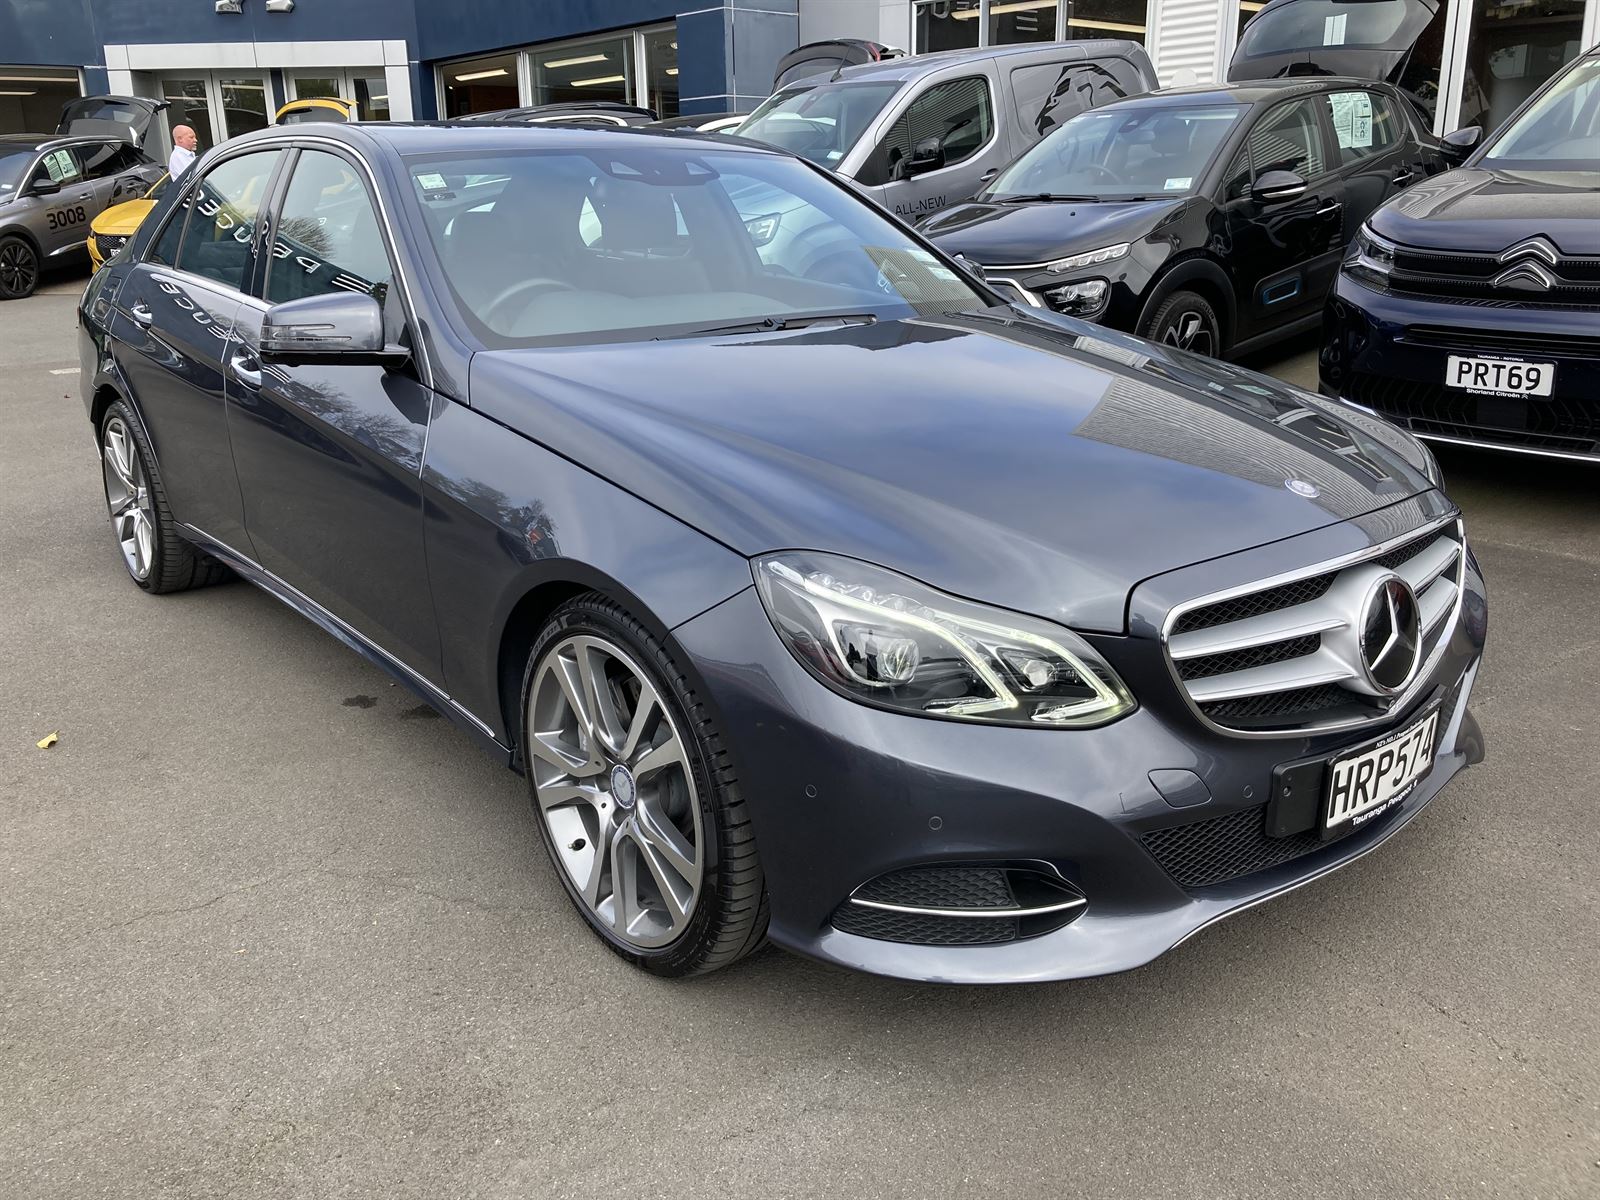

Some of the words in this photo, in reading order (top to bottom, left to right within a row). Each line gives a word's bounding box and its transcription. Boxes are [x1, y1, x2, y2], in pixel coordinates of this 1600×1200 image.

[46, 206, 86, 230] 3008
[895, 194, 946, 215] ALL-NEW
[1457, 360, 1541, 391] PRT69
[1466, 388, 1495, 396] Shorland
[1329, 716, 1436, 819] HRP574
[1352, 803, 1387, 826] Tauranga
[1387, 784, 1412, 808] Peugeot
